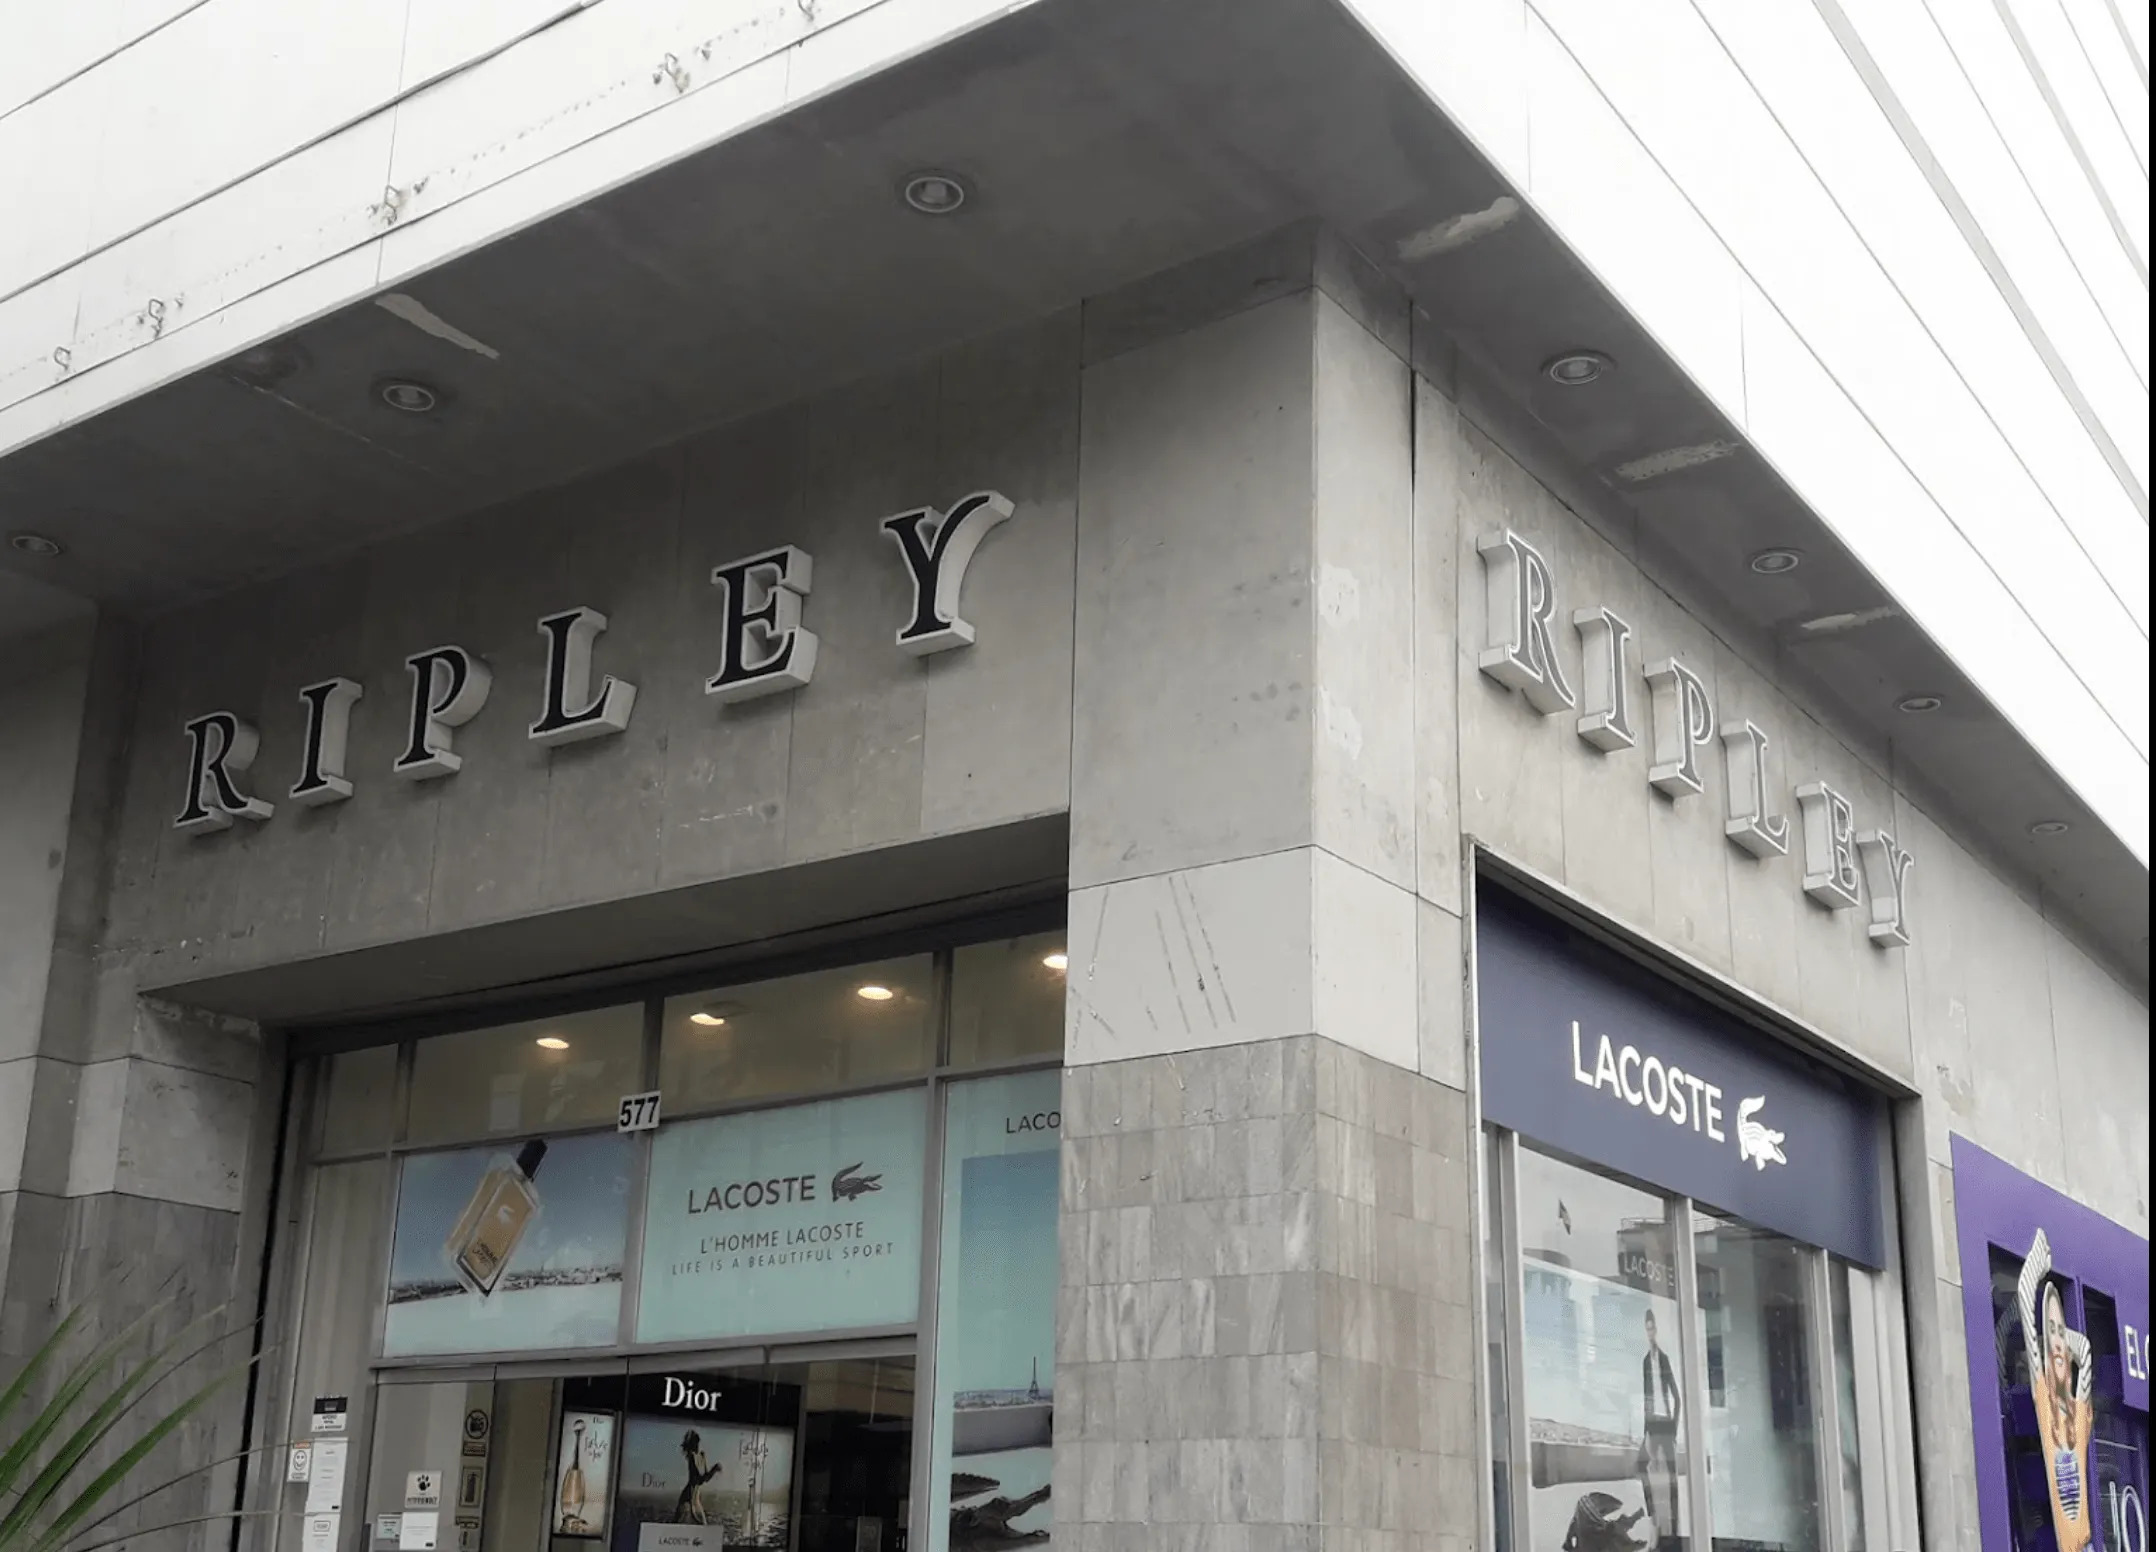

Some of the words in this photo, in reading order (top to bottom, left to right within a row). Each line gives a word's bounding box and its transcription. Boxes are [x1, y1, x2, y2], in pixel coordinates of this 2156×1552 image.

[173, 489, 1015, 835] RIPLEY
[1477, 528, 1915, 948] RIPLEY
[1572, 1020, 1725, 1143] LACOSTE
[619, 1095, 659, 1127] 577
[688, 1174, 816, 1214] LACOSTE
[701, 1230, 779, 1254] L'HOMME
[787, 1221, 864, 1245] LACOSTE
[672, 1261, 701, 1275] LIFE
[711, 1259, 722, 1271] IS
[732, 1258, 740, 1269] A
[749, 1250, 832, 1268] BEAUTIFUL
[843, 1242, 894, 1259] SPORT
[661, 1376, 722, 1411] Dior
